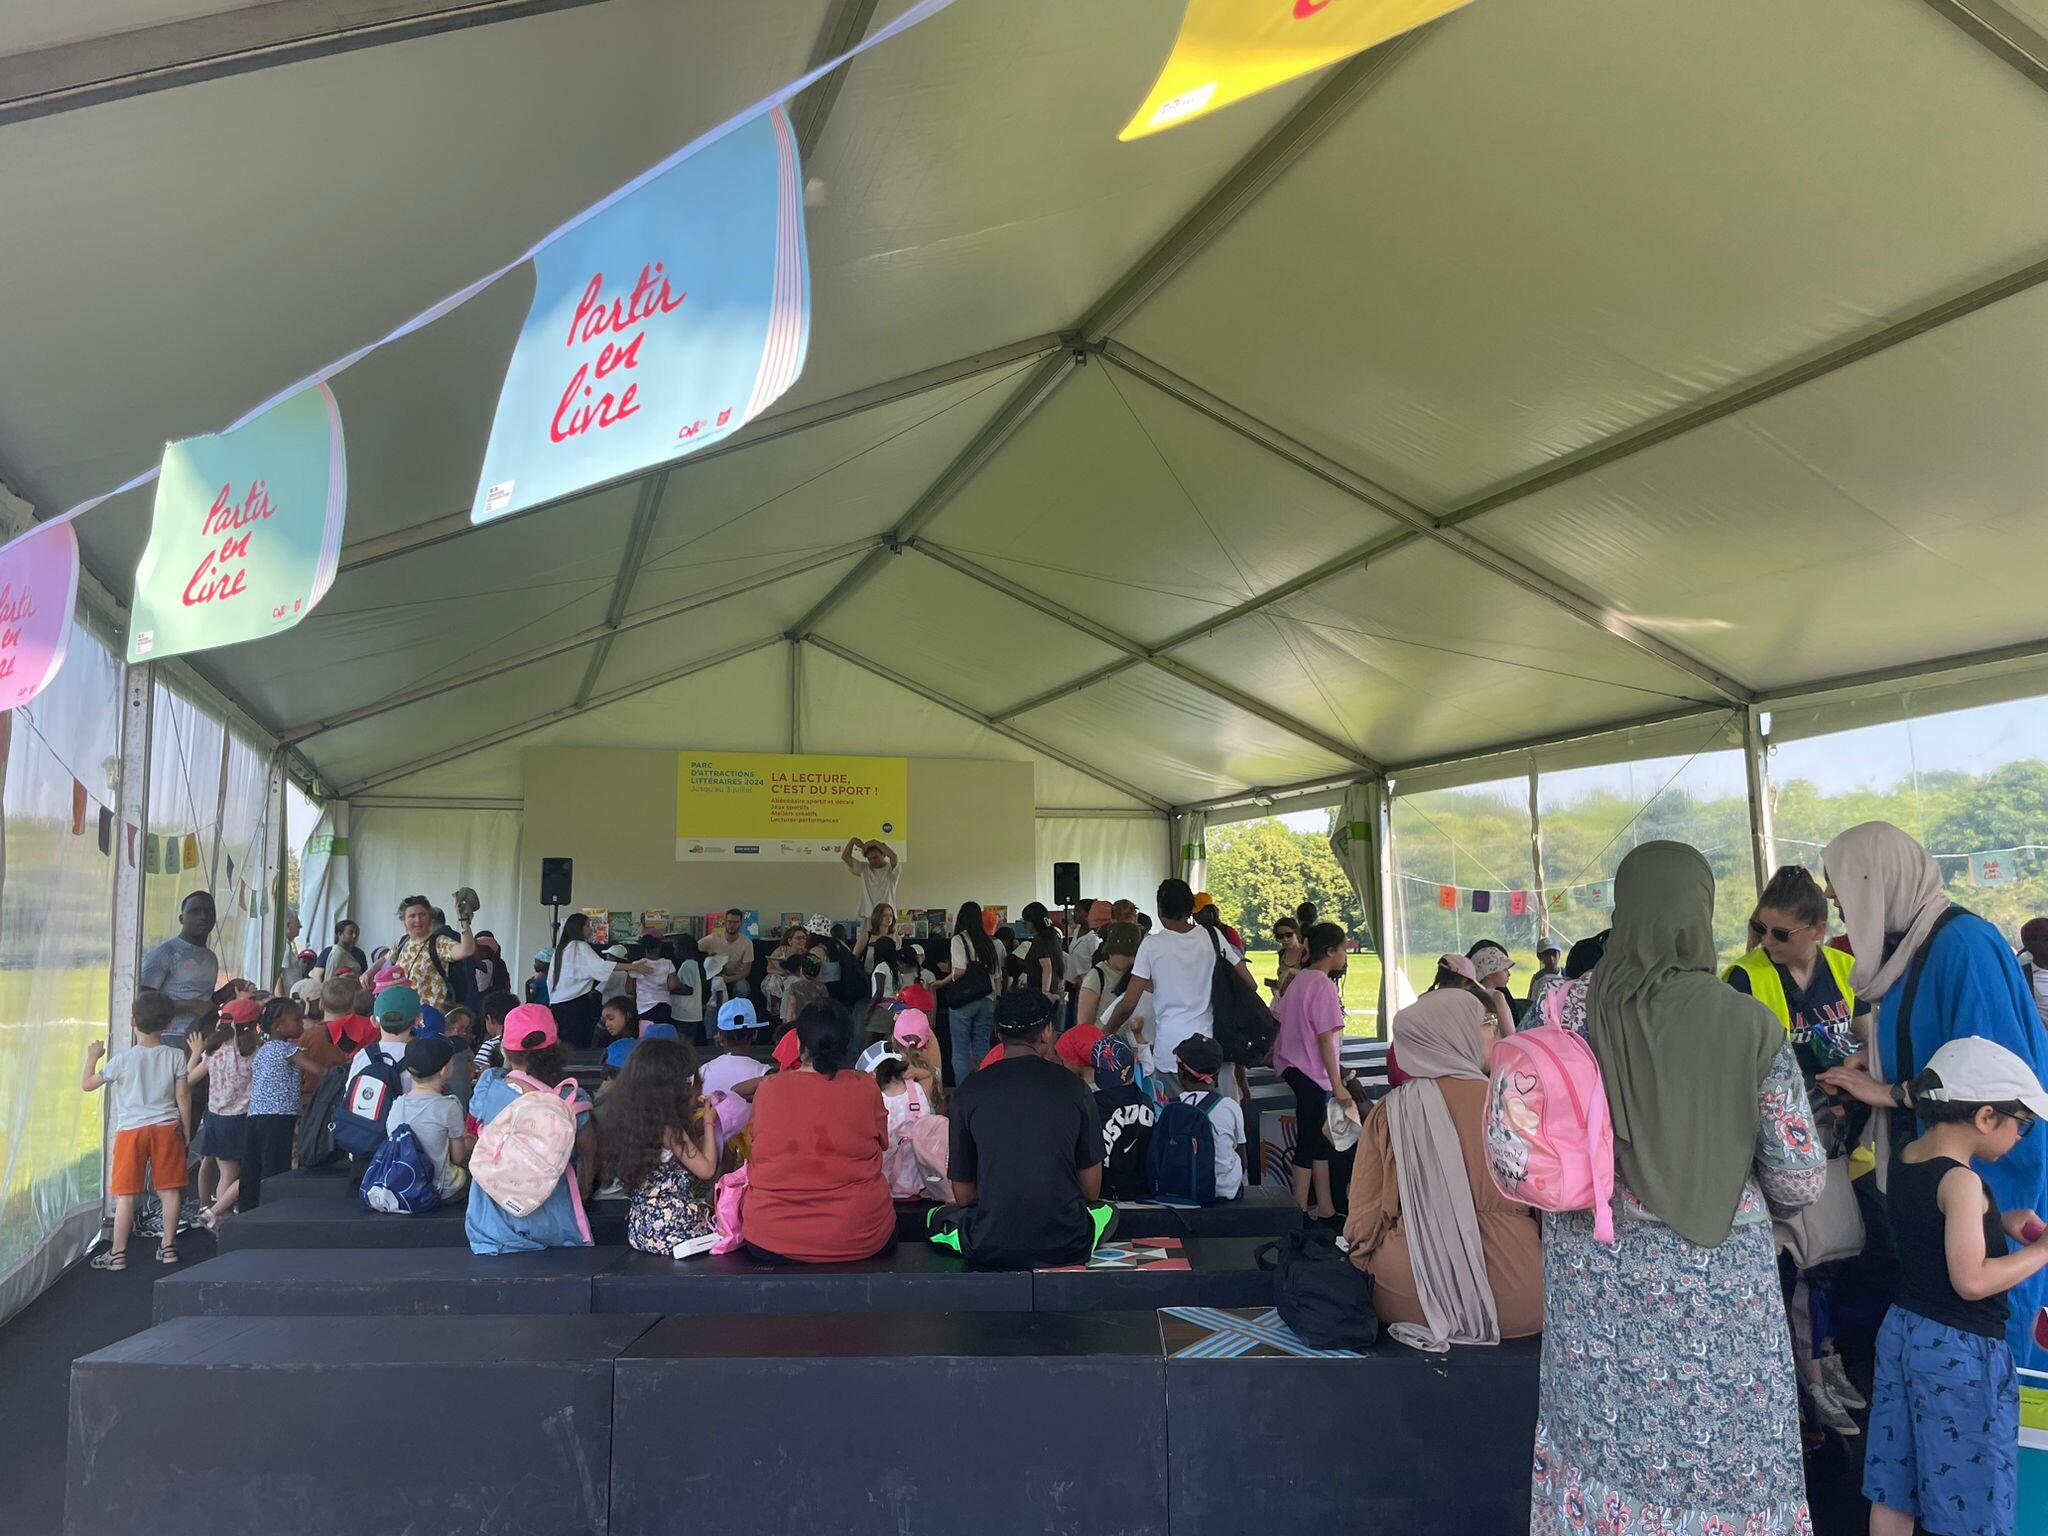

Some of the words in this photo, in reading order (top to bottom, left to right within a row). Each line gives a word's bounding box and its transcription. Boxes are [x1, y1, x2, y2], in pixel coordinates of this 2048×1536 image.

[567, 261, 688, 347] Partir
[594, 331, 645, 379] en
[550, 363, 640, 443] livre
[201, 479, 279, 536] Partir
[220, 531, 253, 565] en
[182, 549, 248, 607] livre
[2, 626, 23, 649] en
[691, 770, 755, 778] D'ATTRACTIONS
[691, 777, 742, 785] LITTÉRAIRES
[771, 772, 787, 782] LA
[792, 773, 851, 785] LECTURE,
[771, 784, 806, 794] C'EST
[810, 785, 827, 795] DU
[831, 786, 871, 796] SPORT
